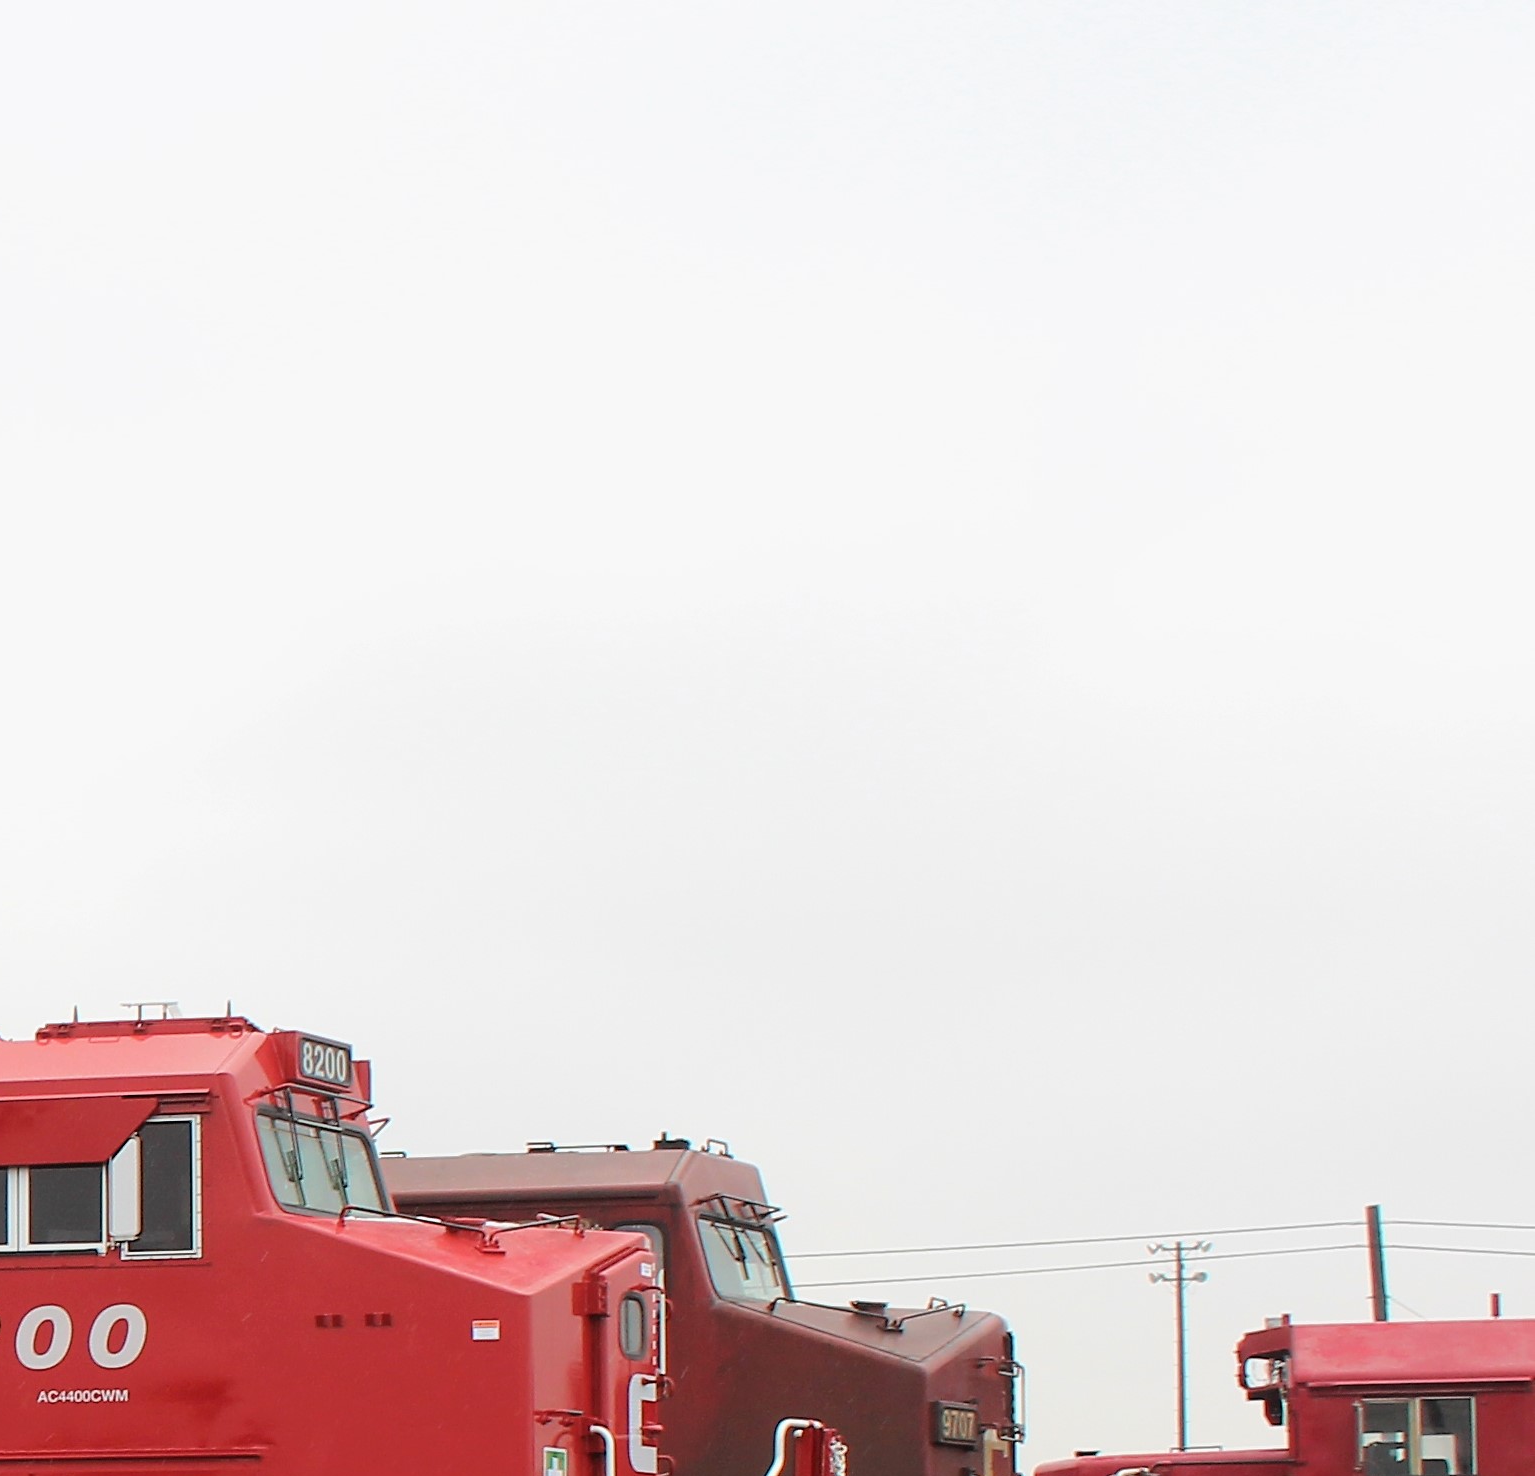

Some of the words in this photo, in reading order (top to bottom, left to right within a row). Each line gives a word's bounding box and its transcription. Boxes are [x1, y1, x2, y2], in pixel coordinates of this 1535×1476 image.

[302, 1041, 347, 1082] 8200
[36, 1388, 130, 1404] AC4400CWM
[941, 1409, 976, 1439] 9707
